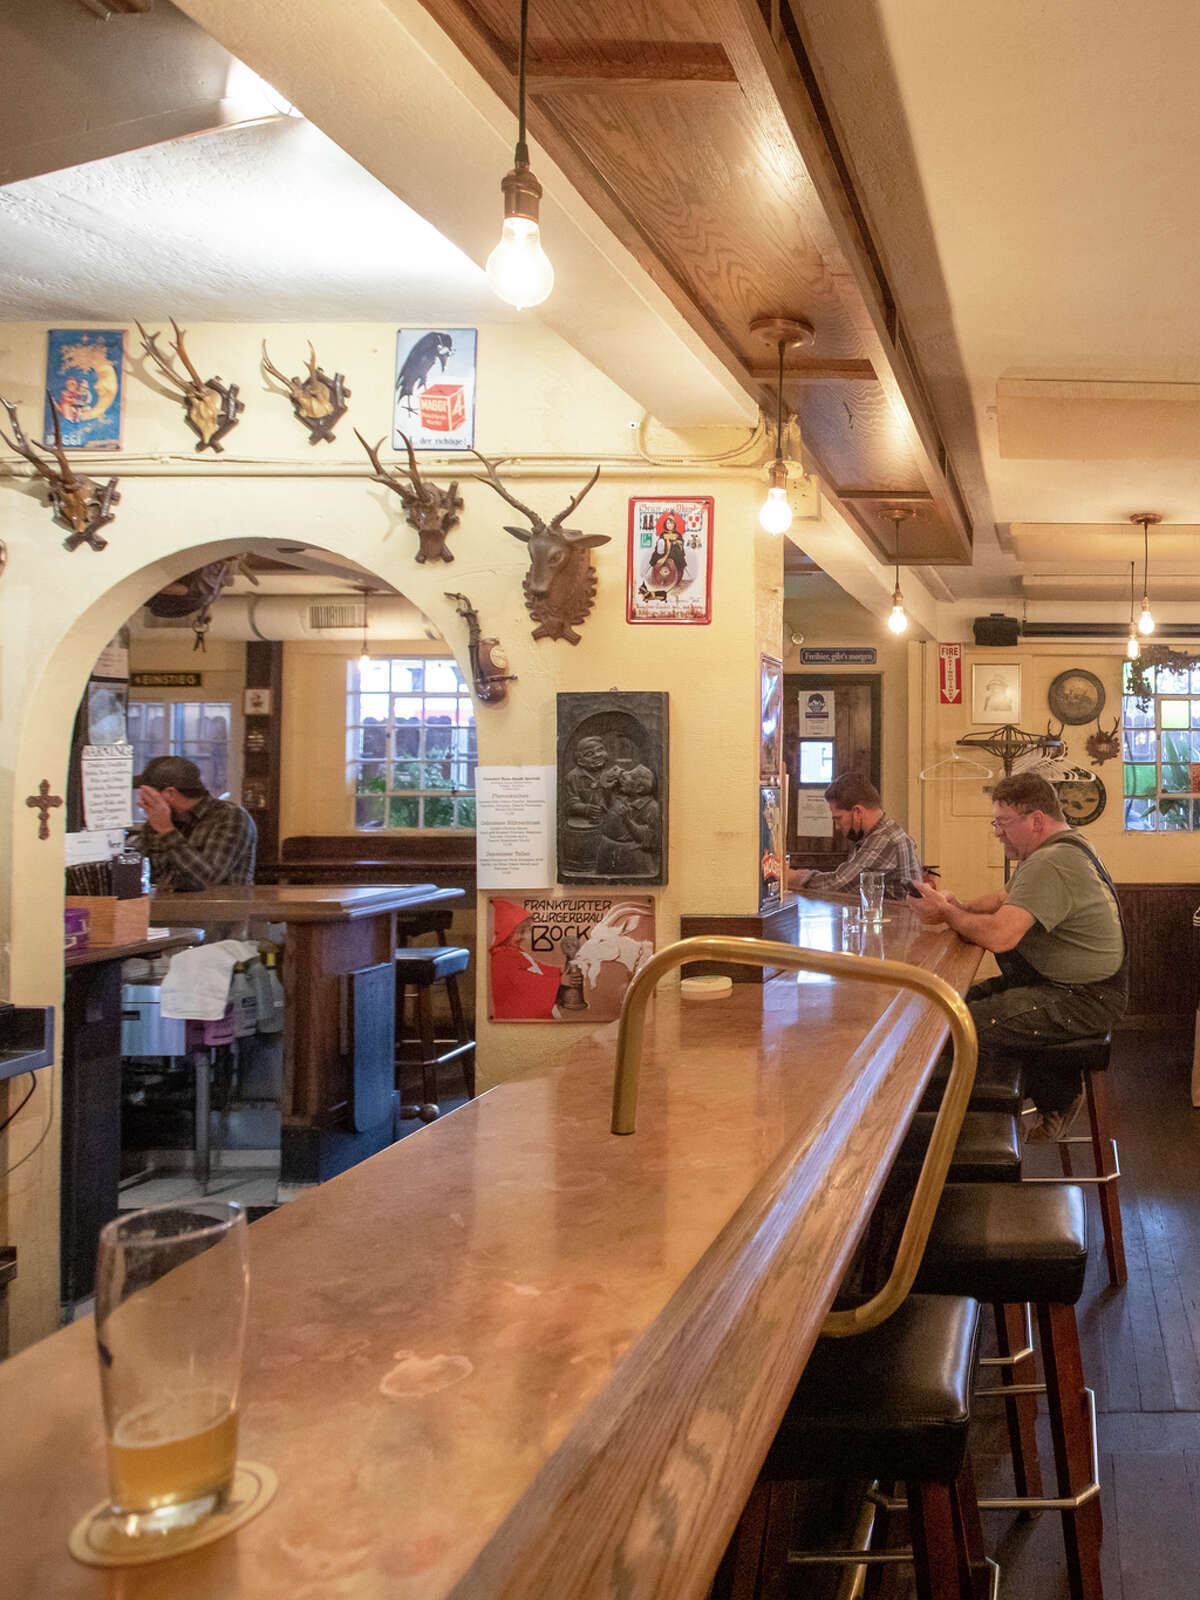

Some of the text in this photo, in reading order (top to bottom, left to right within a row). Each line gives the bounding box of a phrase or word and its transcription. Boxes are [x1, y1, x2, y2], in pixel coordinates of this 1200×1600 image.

[421, 399, 447, 412] MAGGI
[46, 433, 82, 446] MGGI
[941, 647, 958, 656] FIRE
[523, 899, 612, 911] FRANKFURTER
[531, 925, 591, 952] BOCK
